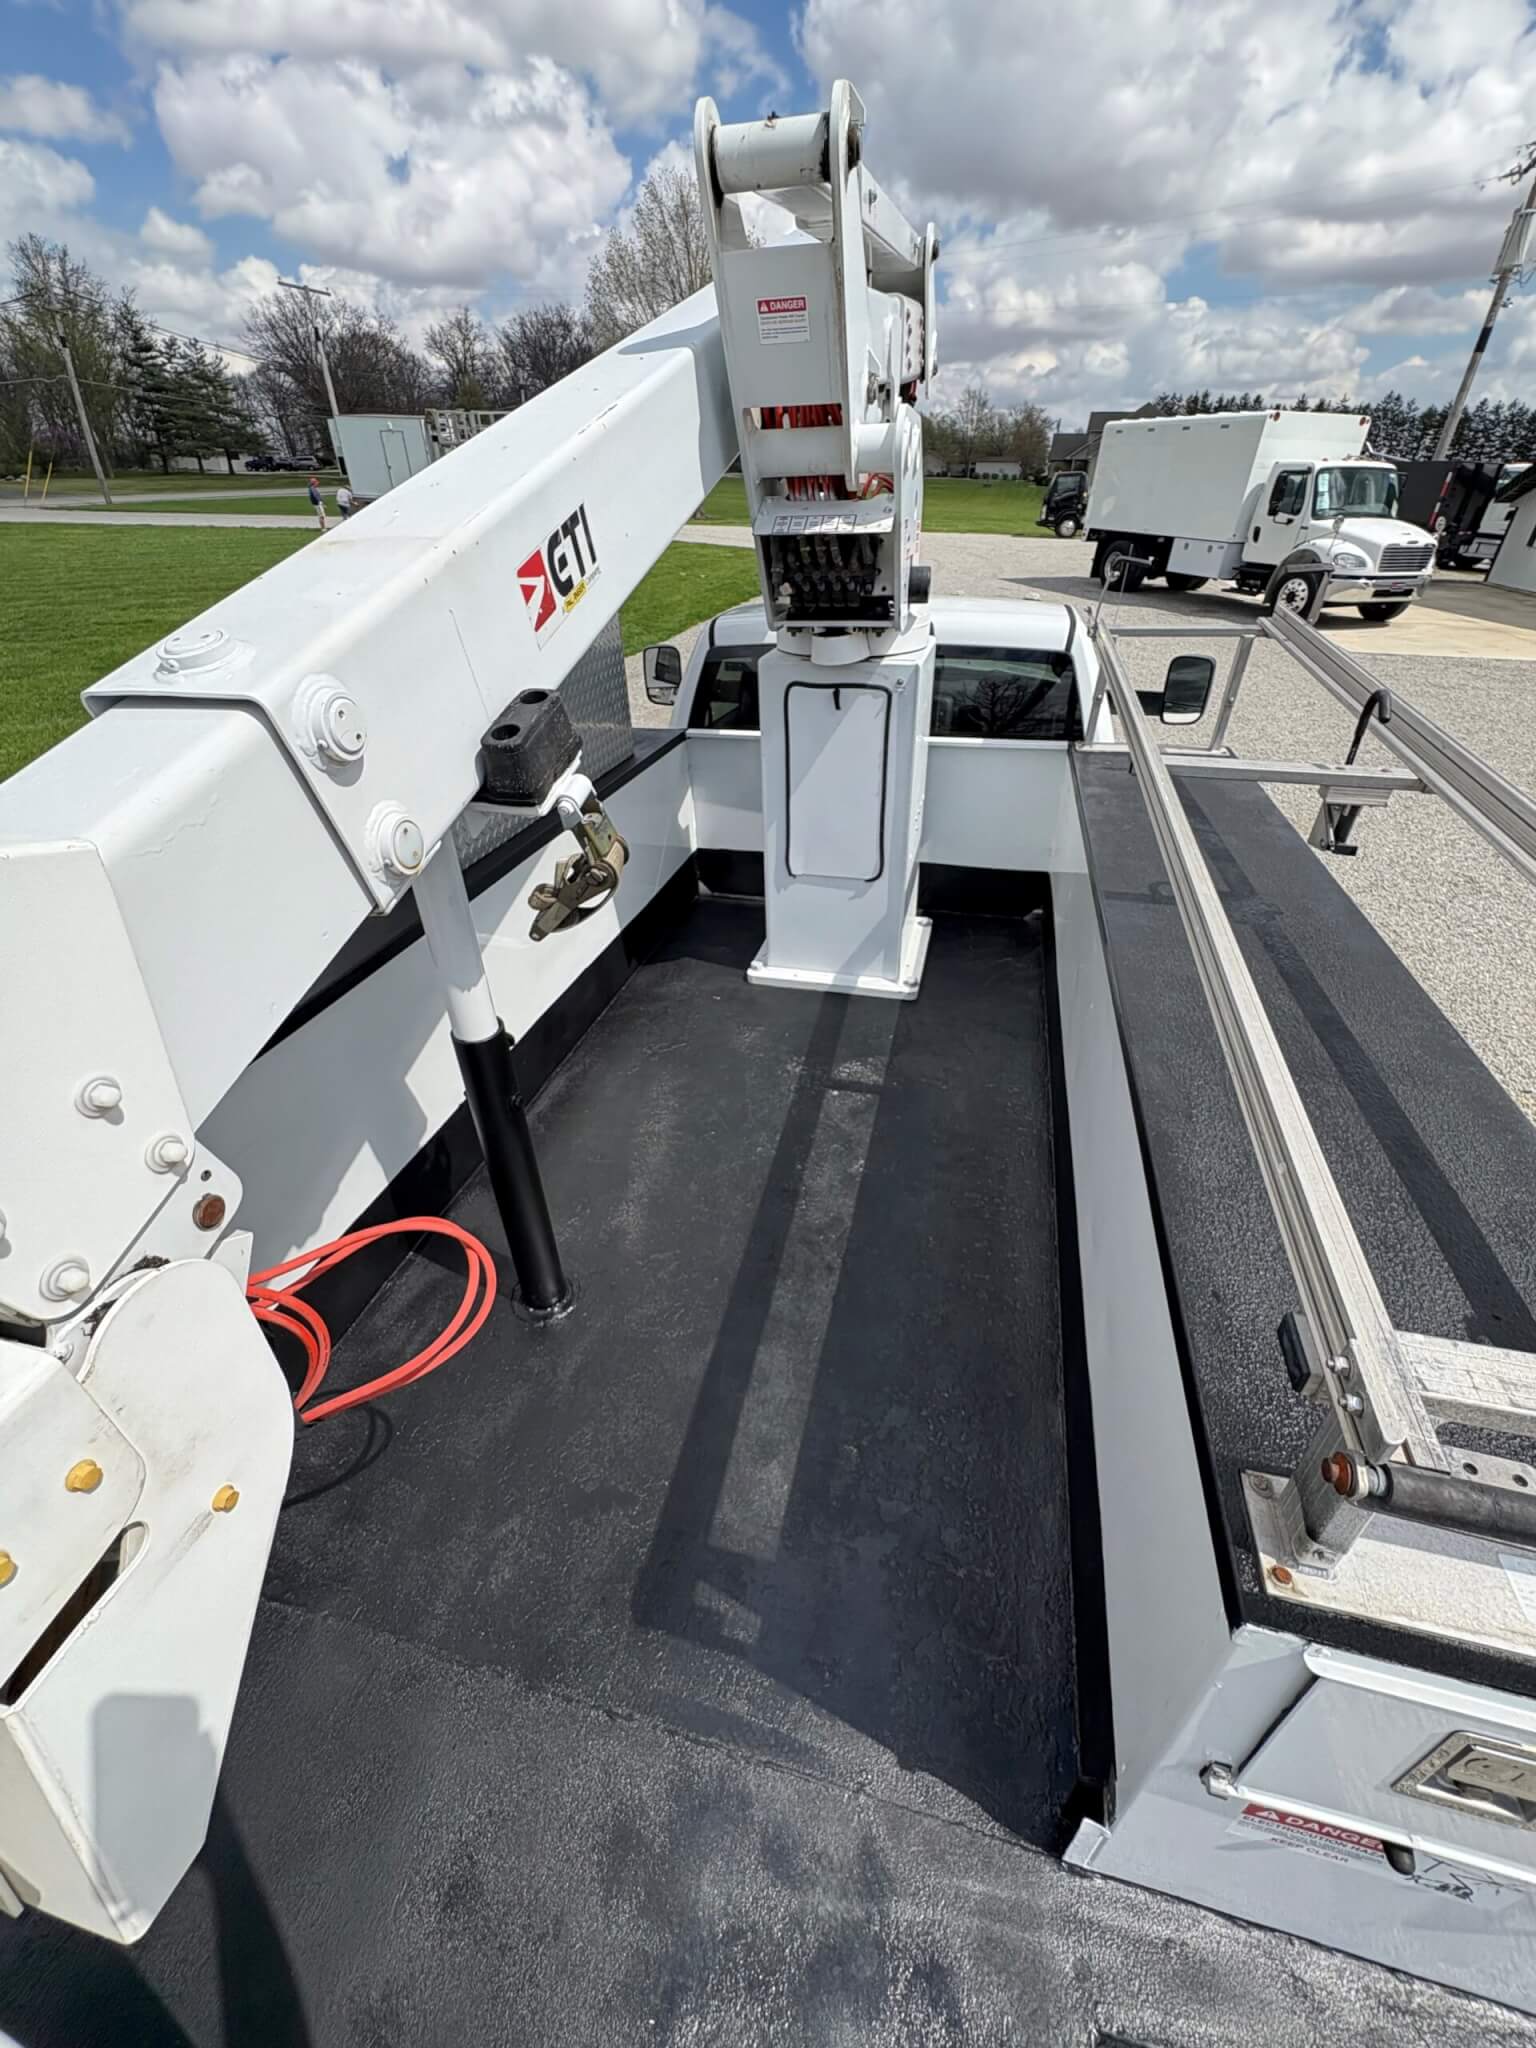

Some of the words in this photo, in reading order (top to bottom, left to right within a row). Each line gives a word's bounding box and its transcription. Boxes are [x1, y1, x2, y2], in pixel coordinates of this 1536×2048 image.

[769, 299, 805, 312] DANGER
[547, 503, 597, 597] ETI
[1242, 1815, 1347, 1848] ELECTROCUTION
[1350, 1845, 1385, 1860] HAZA
[1270, 1837, 1304, 1849] KEEP
[1306, 1847, 1349, 1863] CLEAR
